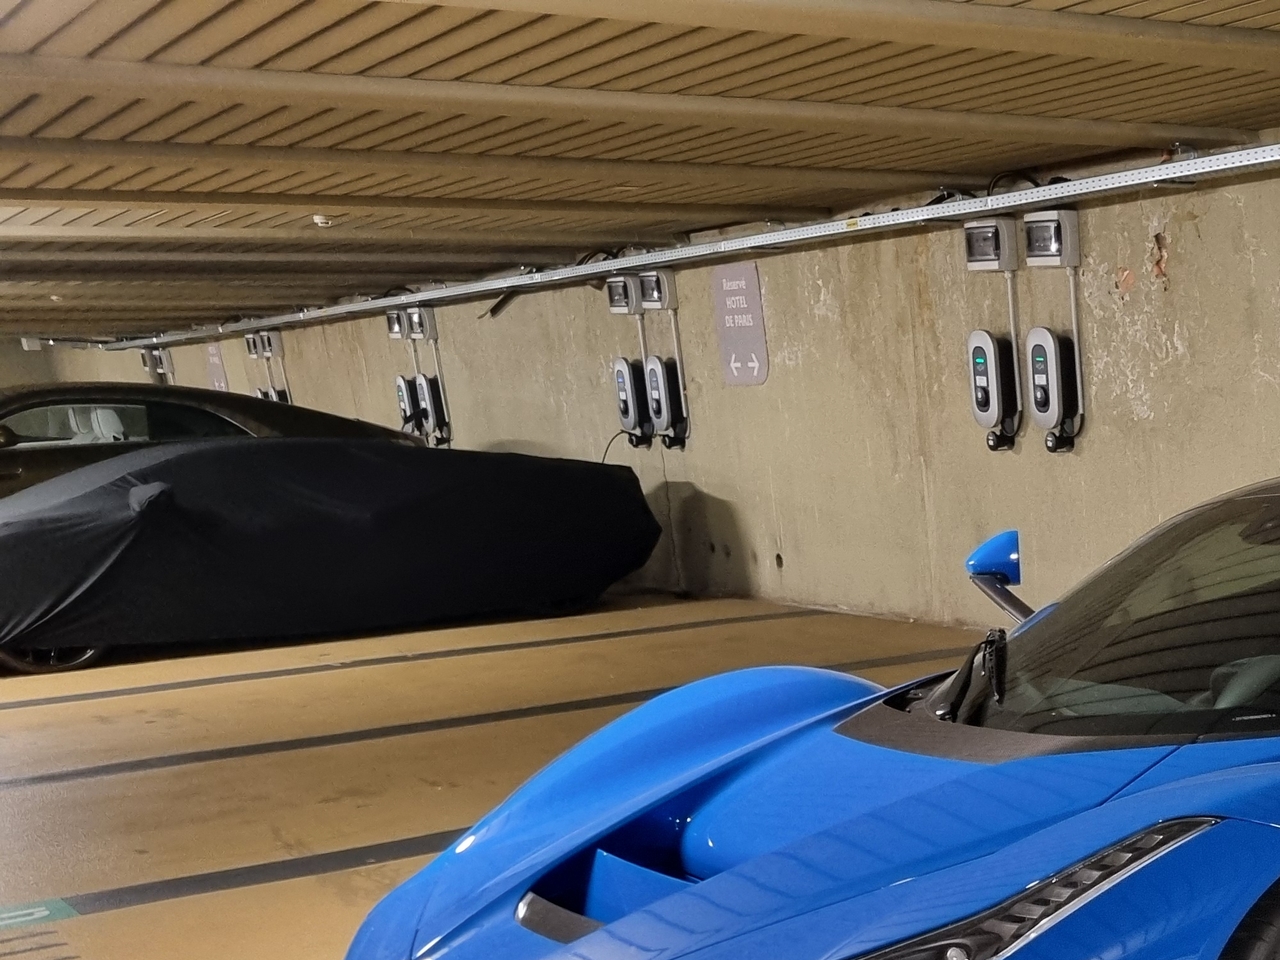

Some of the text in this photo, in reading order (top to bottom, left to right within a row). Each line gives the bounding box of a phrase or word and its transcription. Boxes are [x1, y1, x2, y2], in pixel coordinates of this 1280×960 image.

[726, 295, 748, 309] HOTEL
[725, 313, 754, 327] DE PARIS
